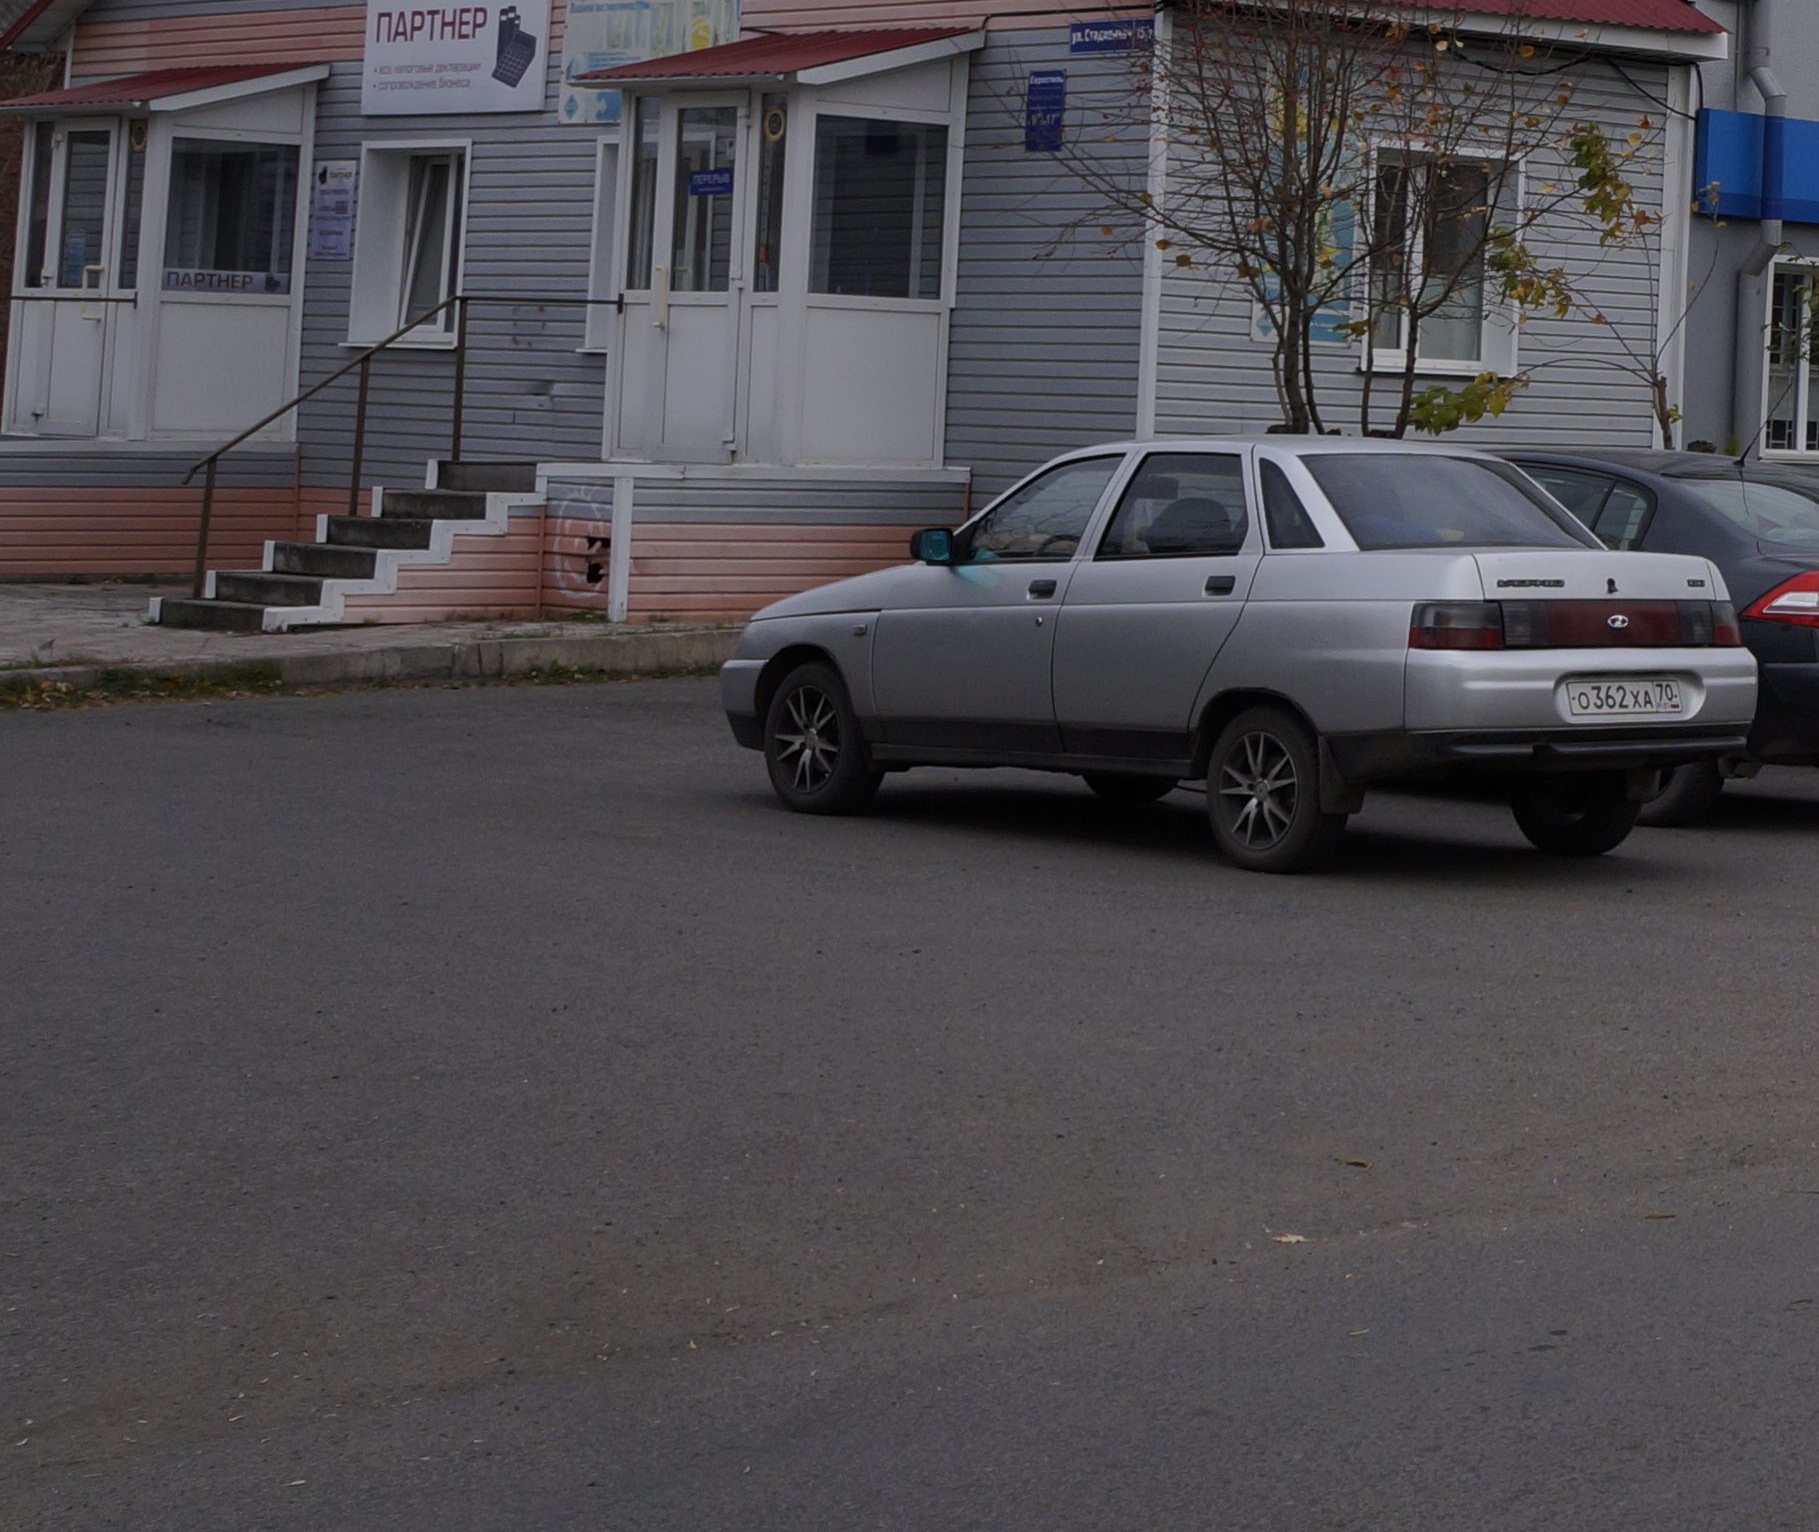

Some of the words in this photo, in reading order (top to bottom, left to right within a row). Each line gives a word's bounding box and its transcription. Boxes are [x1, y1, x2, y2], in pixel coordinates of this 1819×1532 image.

[376, 7, 488, 44] ПАРТНЕР
[166, 271, 254, 290] ПАРТНЕР
[1577, 685, 1654, 710] О362ХА
[1655, 683, 1673, 702] 70
